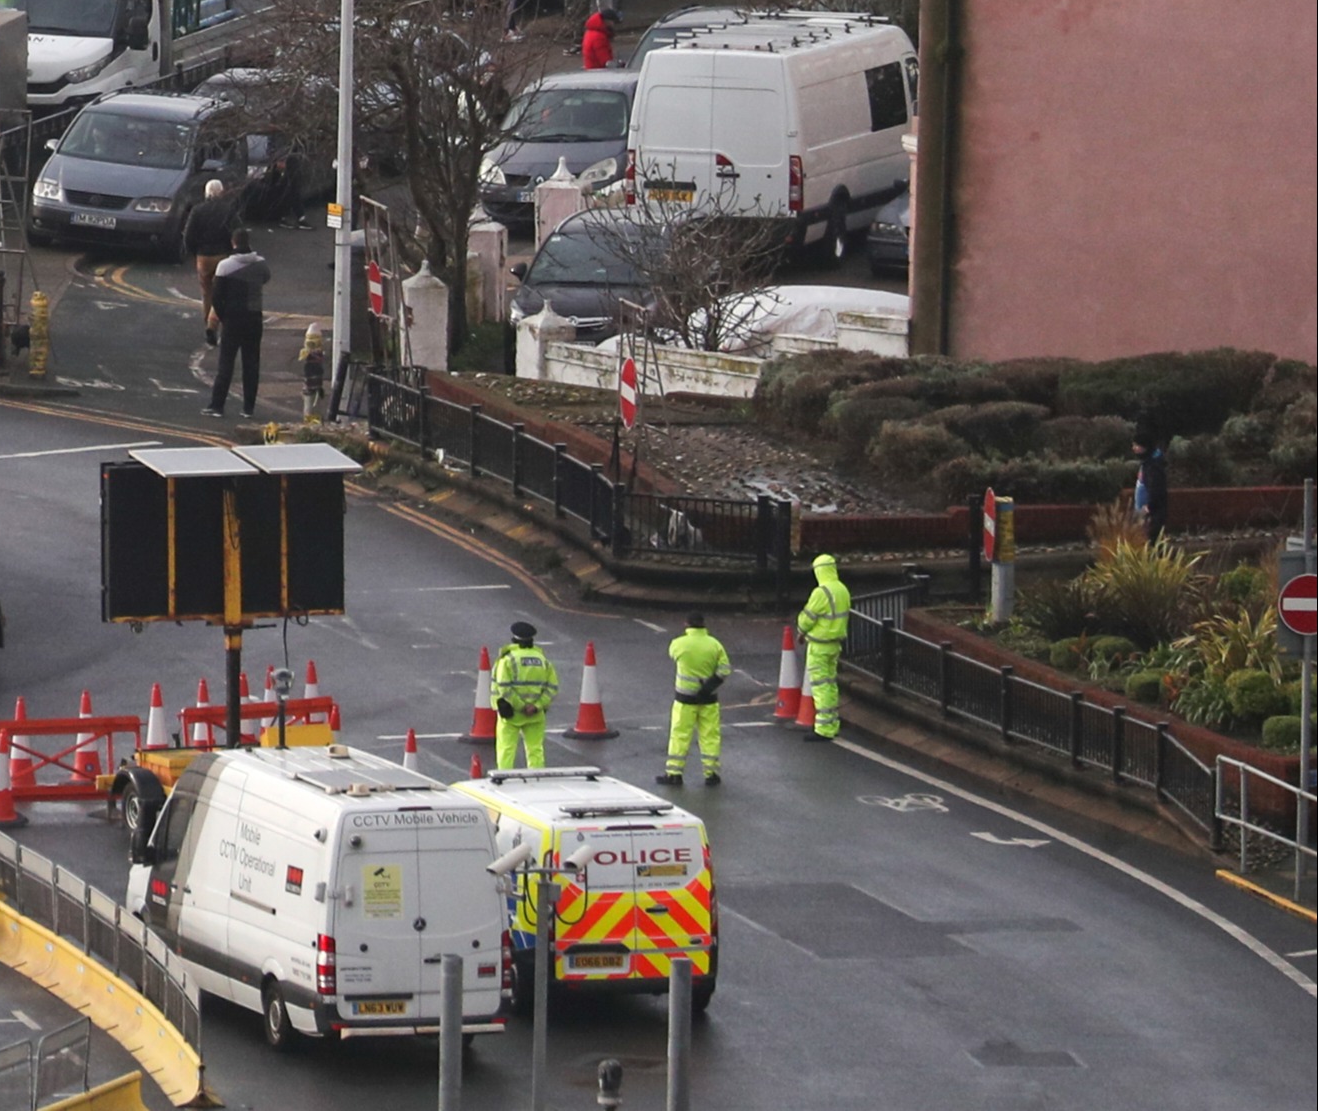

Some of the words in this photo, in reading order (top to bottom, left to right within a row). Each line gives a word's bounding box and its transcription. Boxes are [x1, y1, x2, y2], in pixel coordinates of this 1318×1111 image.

[353, 815, 390, 827] CCTV
[395, 813, 434, 825] Mobile
[437, 812, 479, 824] Vehicle
[241, 822, 261, 845] Mobile
[219, 839, 239, 860] CCTV
[239, 848, 276, 877] Operational
[593, 848, 692, 865] OLICE
[239, 872, 252, 893] Unit
